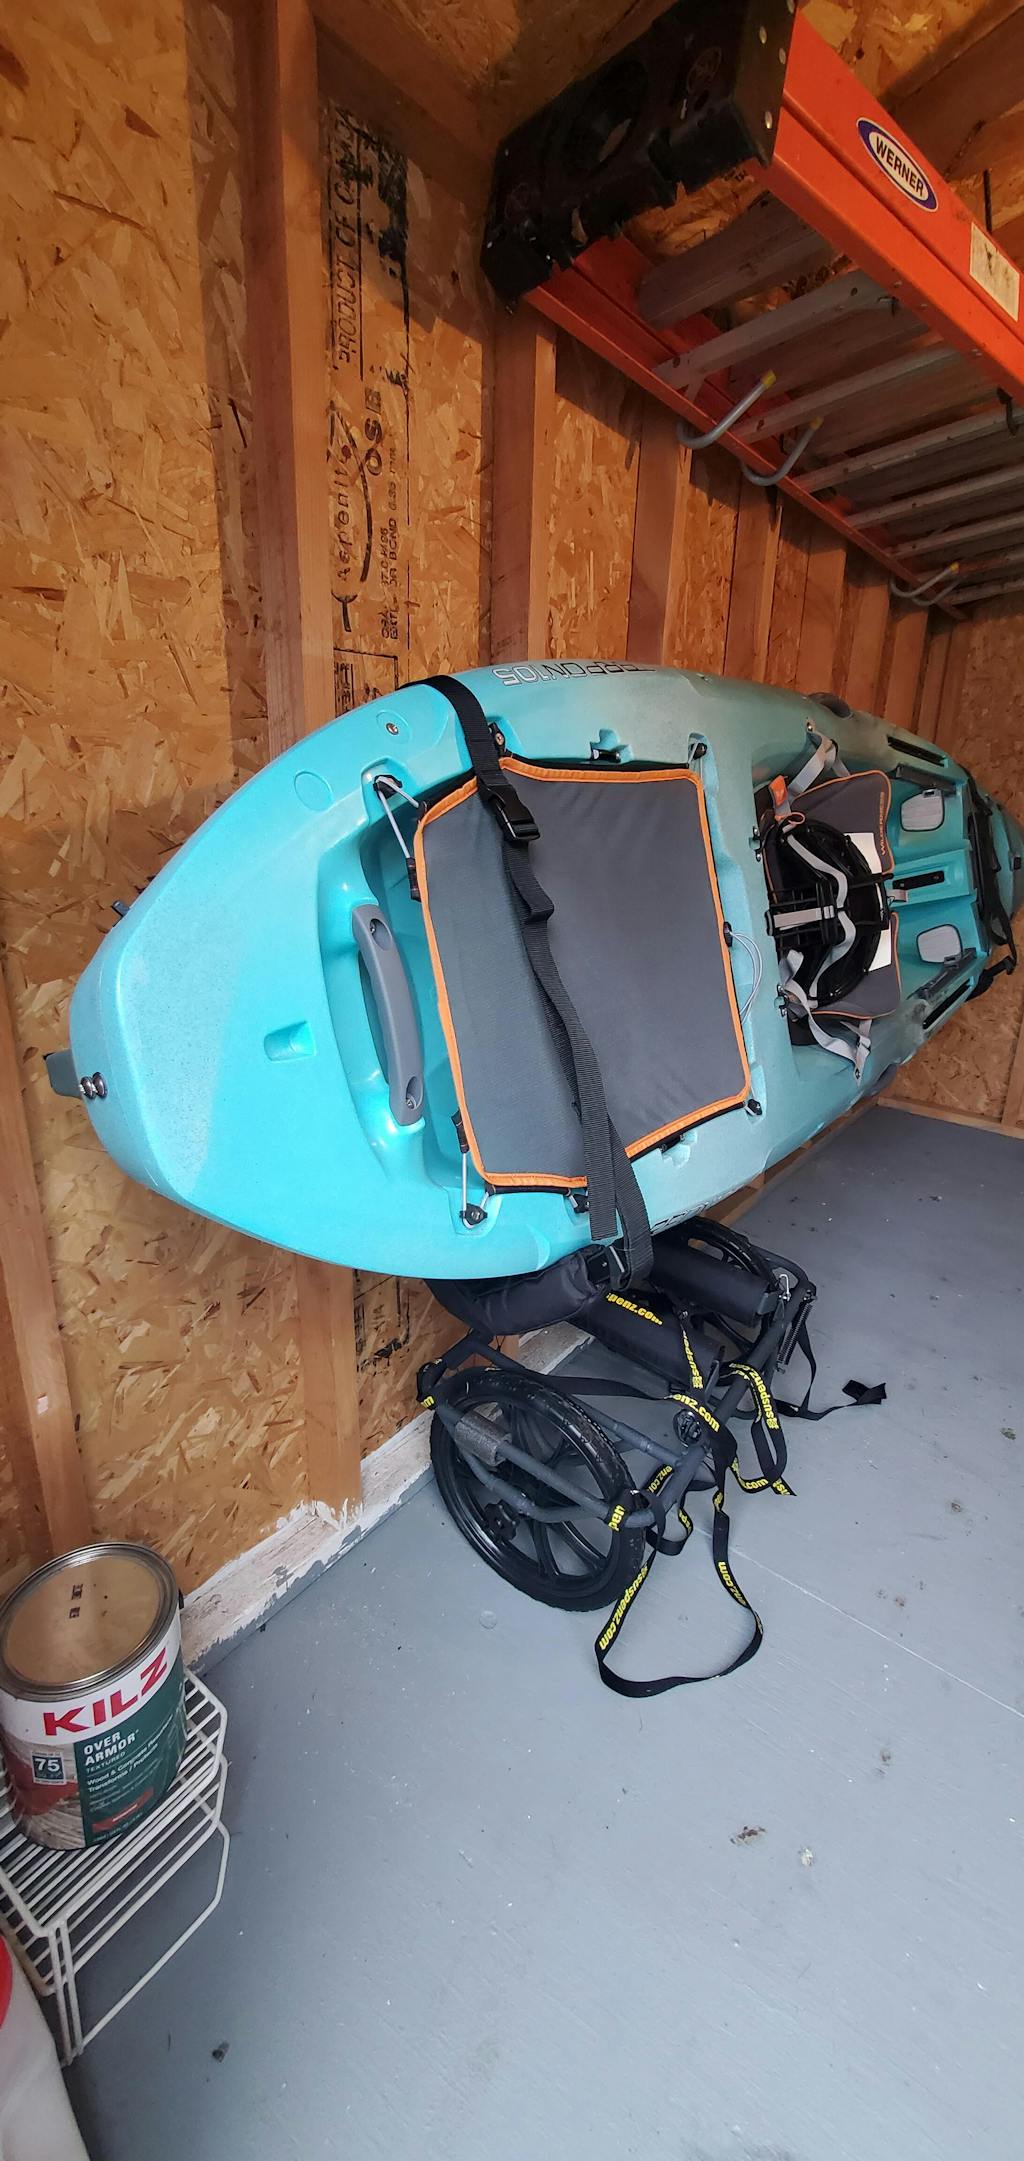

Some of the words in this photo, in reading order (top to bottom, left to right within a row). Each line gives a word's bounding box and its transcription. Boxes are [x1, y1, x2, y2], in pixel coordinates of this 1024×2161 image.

[876, 136, 924, 197] WERNER
[334, 213, 356, 247] OF
[335, 256, 358, 364] PRODUCT
[364, 388, 382, 476] OSB
[389, 517, 398, 561] BOND
[43, 1647, 168, 1737] KILZ
[83, 1731, 121, 1756] OVER
[84, 1733, 136, 1767] ARMOR
[86, 1751, 126, 1774] TEXTURED
[34, 1757, 60, 1772] 75
